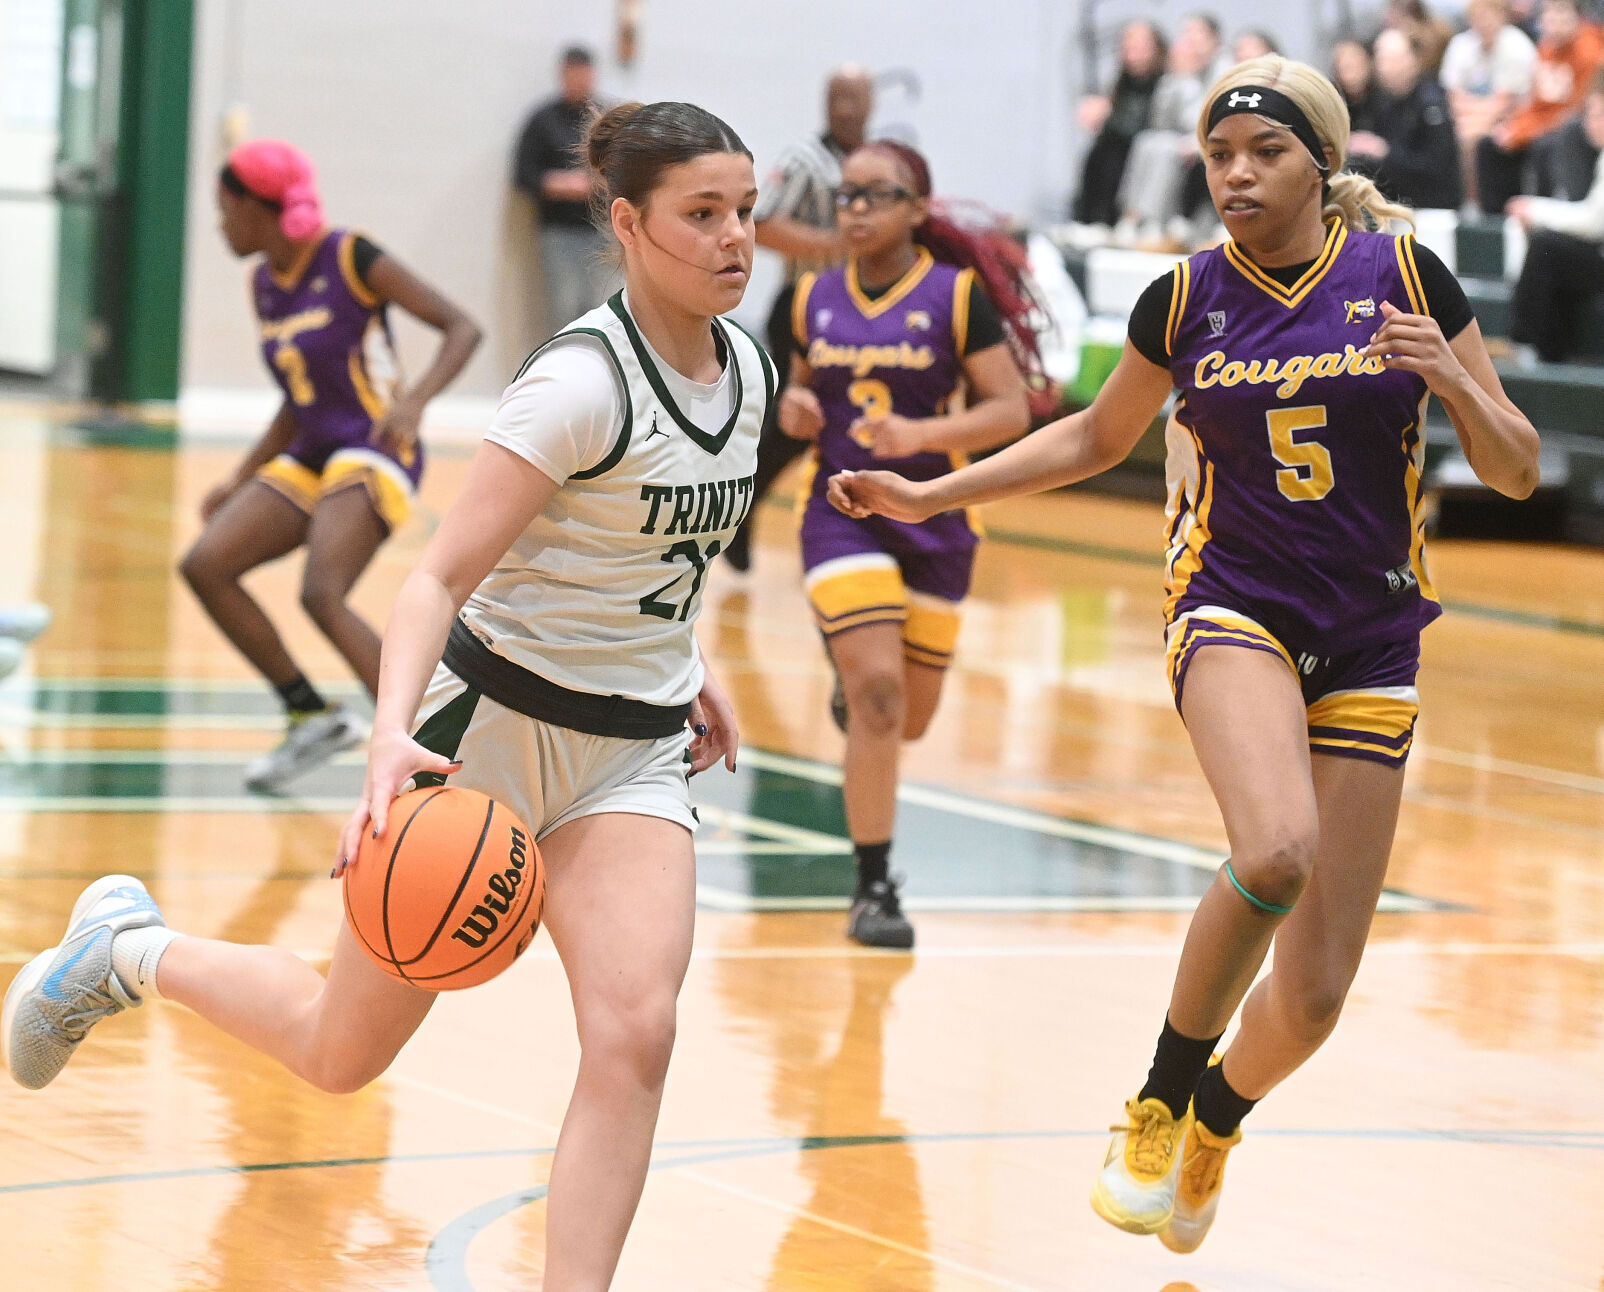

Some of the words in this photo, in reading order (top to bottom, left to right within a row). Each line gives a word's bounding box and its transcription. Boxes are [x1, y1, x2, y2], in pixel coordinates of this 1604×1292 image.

[1195, 344, 1388, 399] Cougars
[1266, 405, 1335, 502] 5
[640, 475, 755, 536] TRINIT
[639, 539, 721, 621] 21
[451, 826, 527, 949] Wilson
